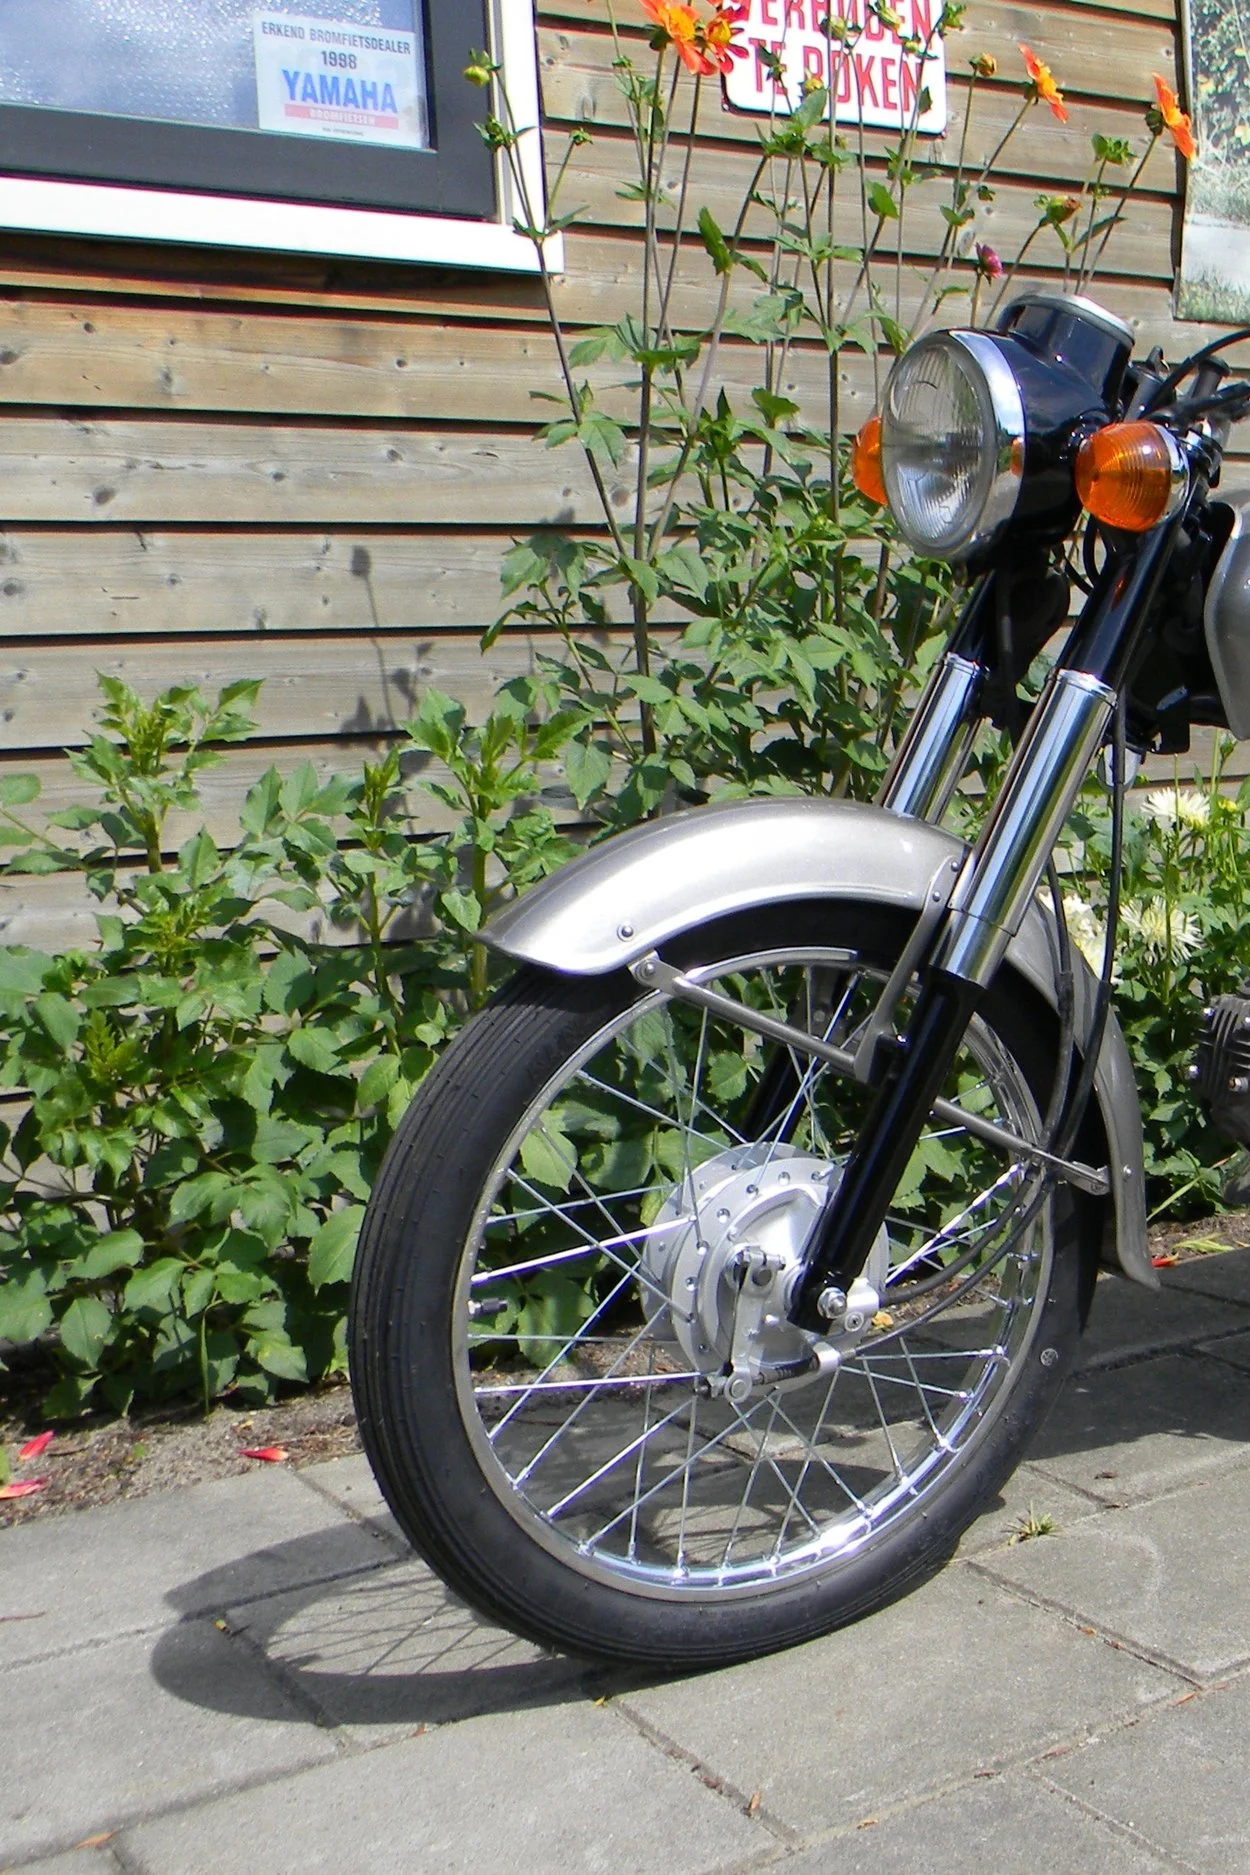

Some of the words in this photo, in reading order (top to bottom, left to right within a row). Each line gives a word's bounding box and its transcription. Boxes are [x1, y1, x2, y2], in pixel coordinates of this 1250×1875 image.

[262, 21, 305, 40] ERKEND
[310, 28, 411, 54] BROMFIETSDEALER
[321, 51, 358, 69] 1998
[749, 37, 788, 96] TE
[803, 45, 922, 112] ROKEN
[281, 69, 398, 113] YAMAHA
